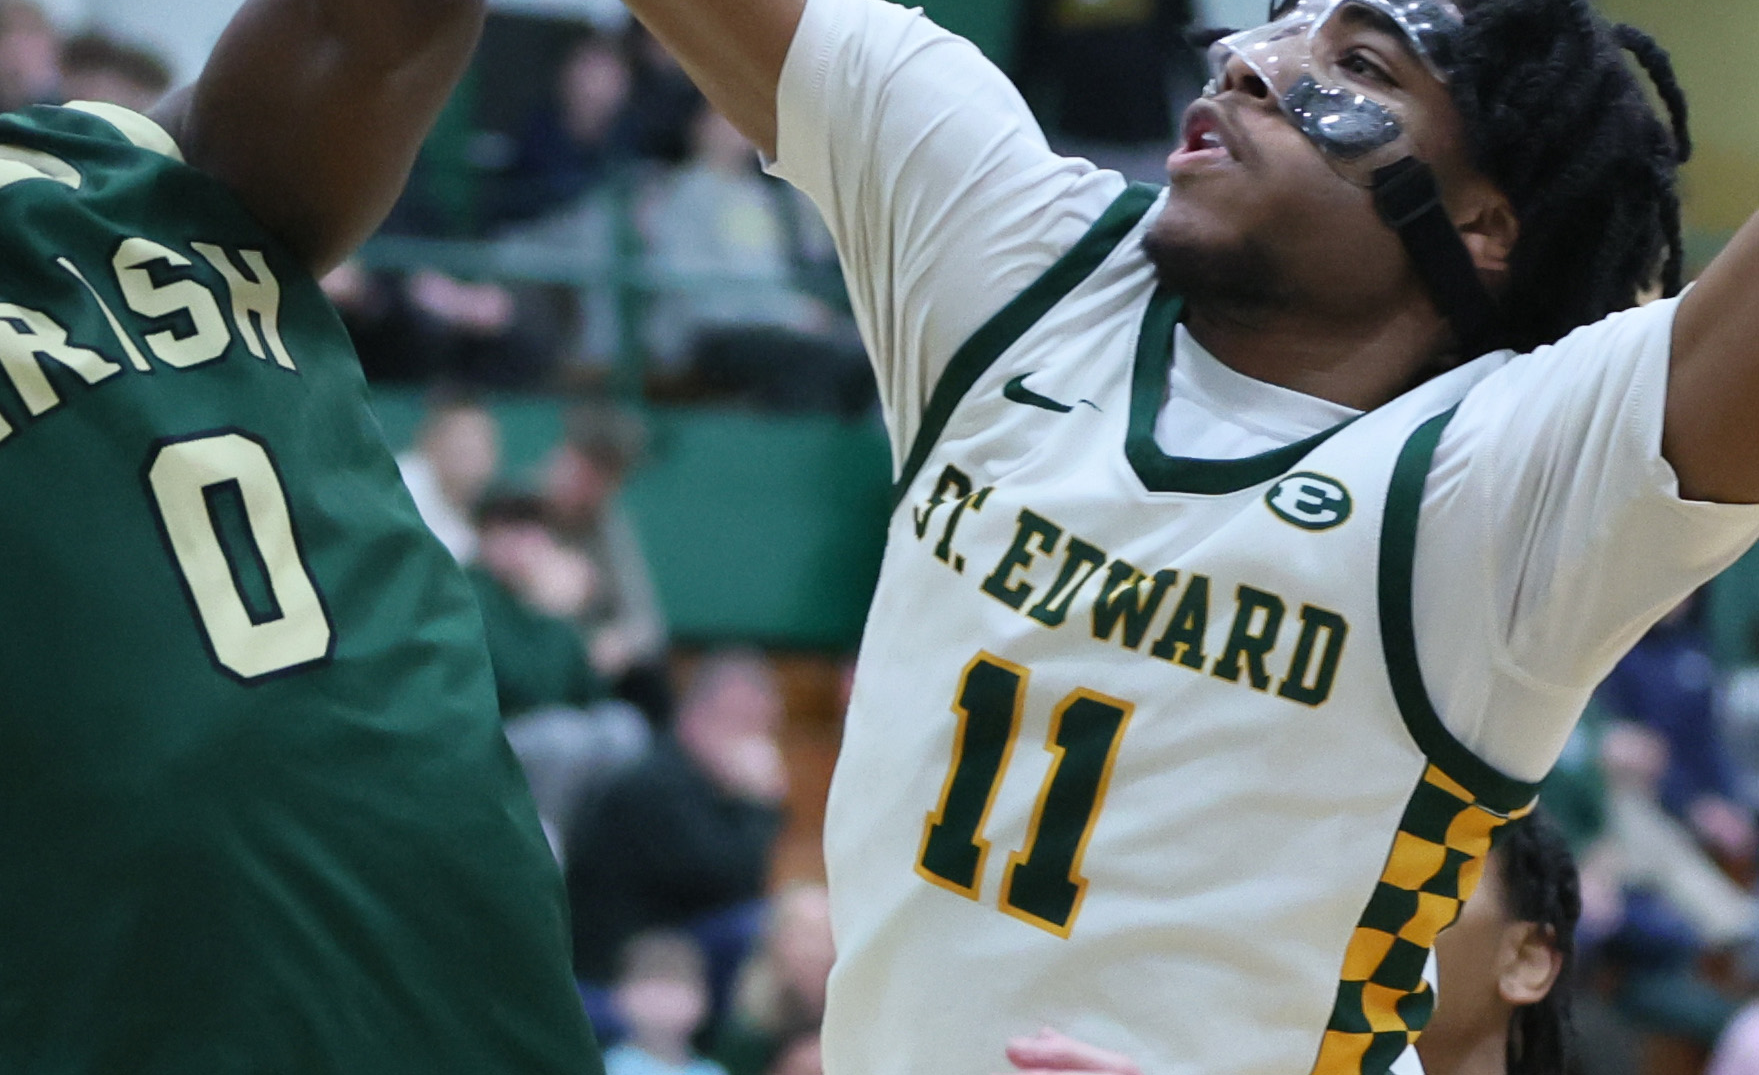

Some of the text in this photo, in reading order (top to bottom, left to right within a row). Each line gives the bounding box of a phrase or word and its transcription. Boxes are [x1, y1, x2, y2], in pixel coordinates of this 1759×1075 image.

[146, 429, 336, 684] 0
[912, 464, 1350, 708] ST. EDWARD
[914, 649, 1135, 940] 11
